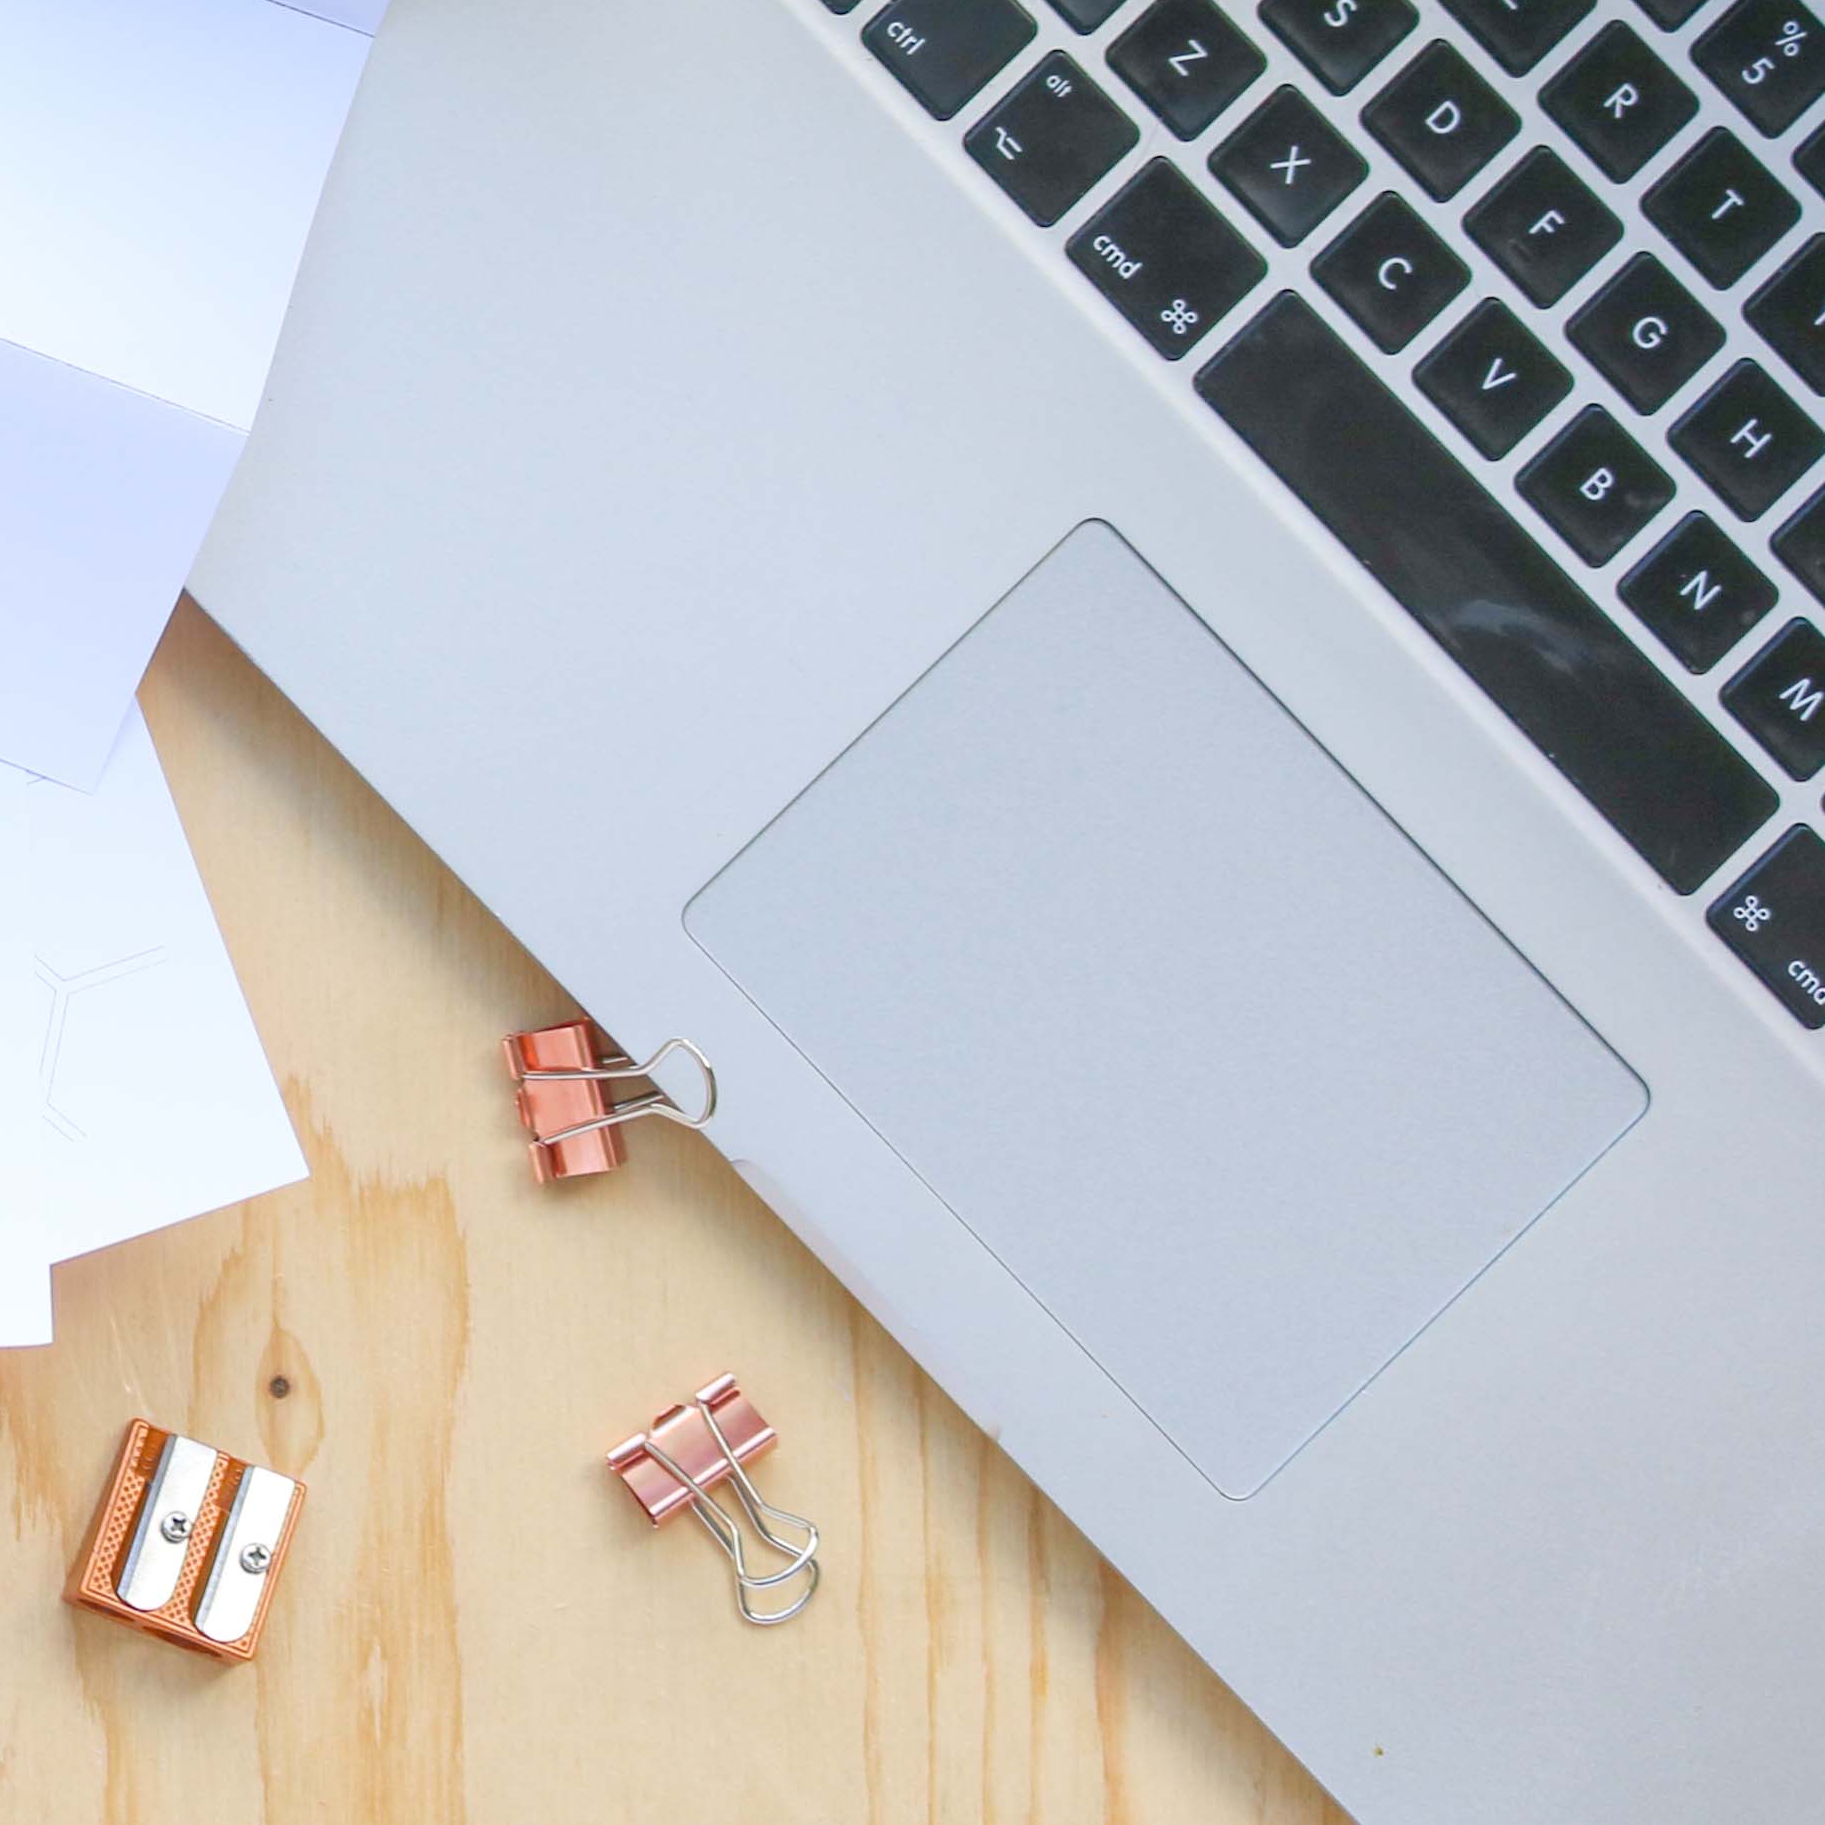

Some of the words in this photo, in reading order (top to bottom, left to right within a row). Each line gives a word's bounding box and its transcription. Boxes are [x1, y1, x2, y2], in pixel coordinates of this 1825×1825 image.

[886, 21, 926, 55] ctrl
[1774, 20, 1808, 57] %
[1168, 39, 1208, 77] Z
[1741, 57, 1775, 85] 5
[1046, 74, 1073, 98] alt
[1603, 82, 1639, 119] R
[1424, 100, 1461, 135] D
[1270, 145, 1312, 185] X
[1711, 189, 1744, 220] T
[1528, 209, 1566, 235] F
[1092, 235, 1143, 280] cmd
[1378, 257, 1413, 290] C
[1632, 316, 1668, 349] G
[1481, 357, 1517, 390] V
[1729, 418, 1772, 459] H
[1579, 467, 1614, 501] B
[1679, 570, 1722, 611] N
[1778, 677, 1824, 722] M
